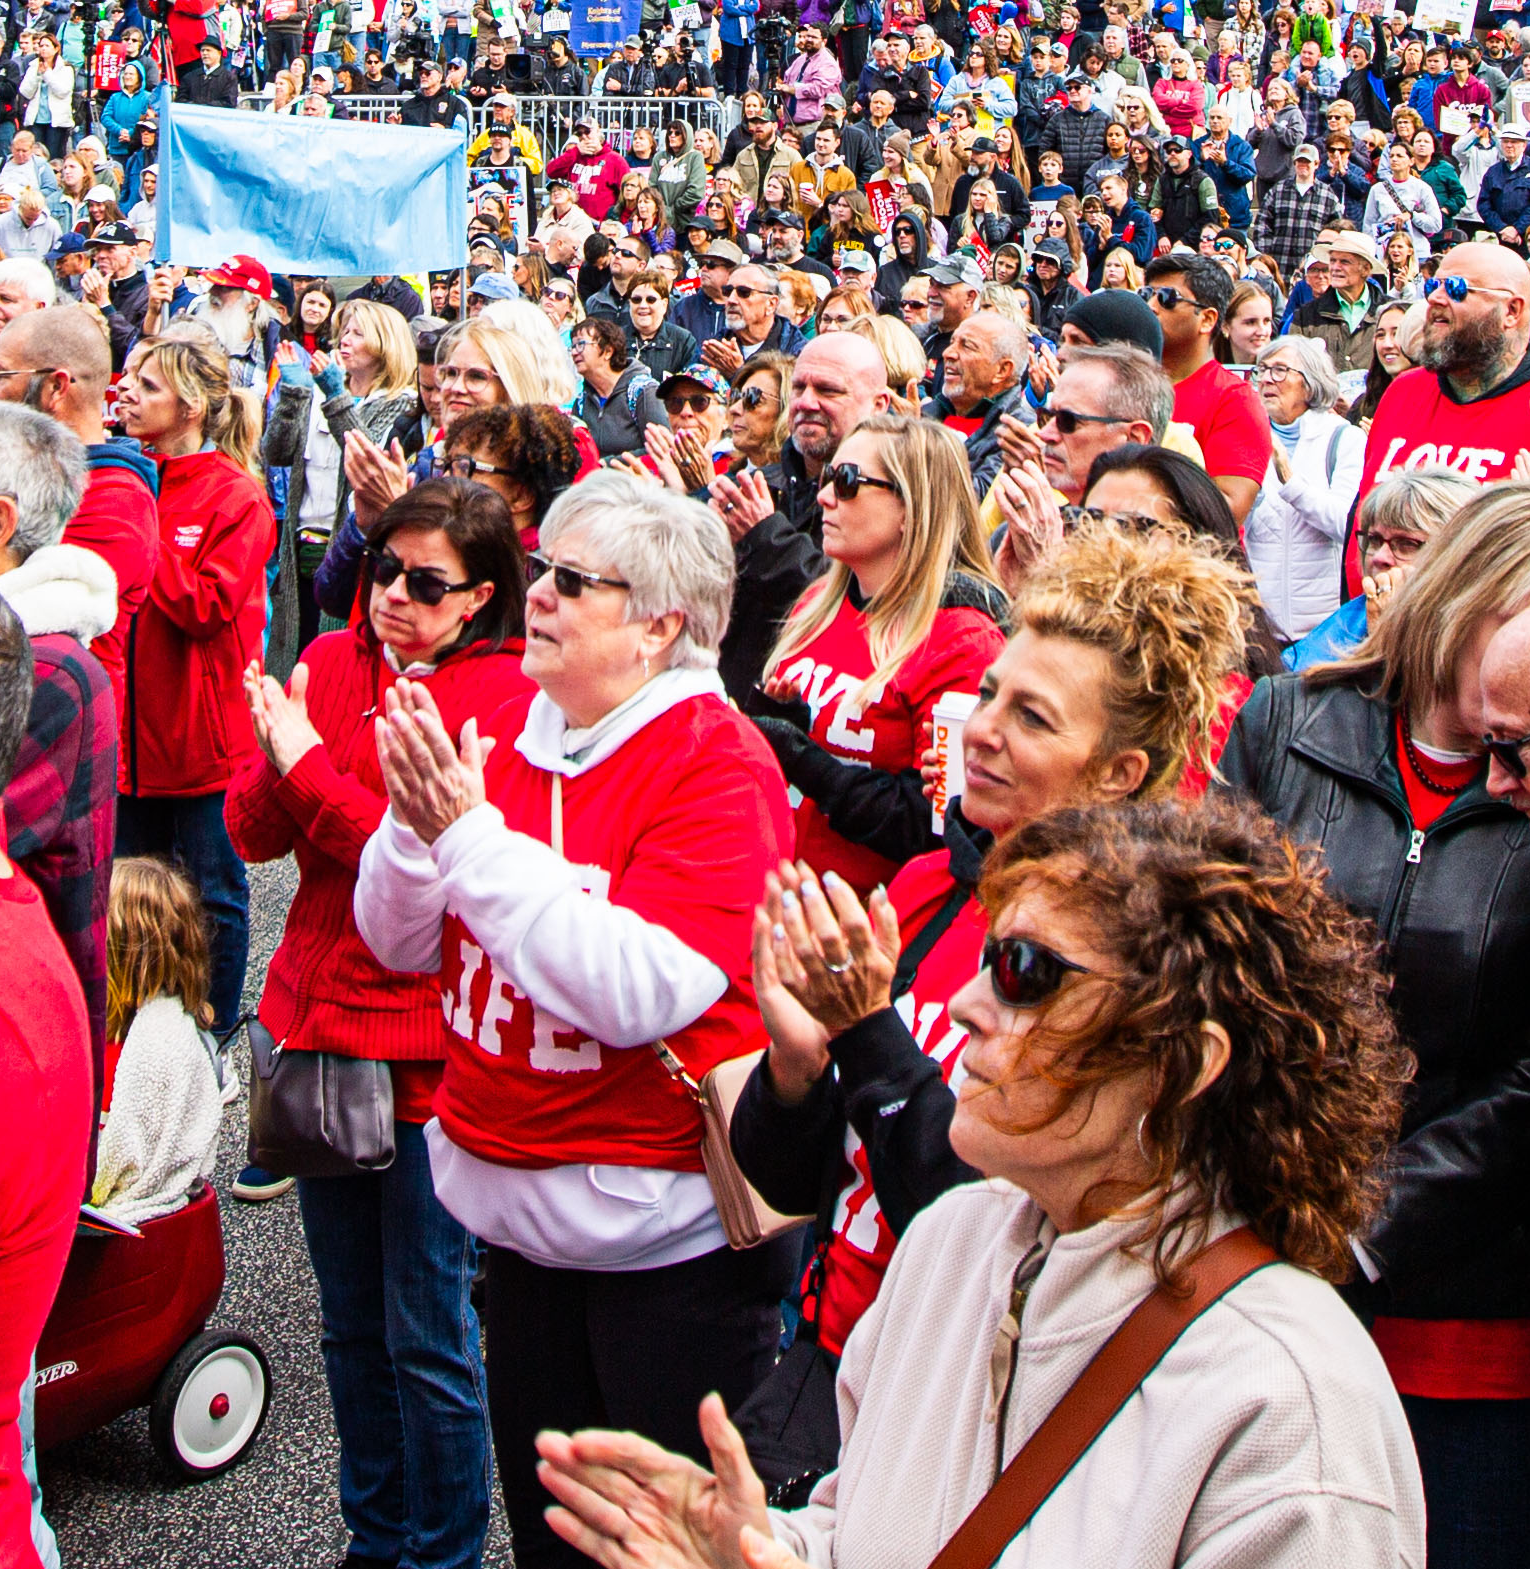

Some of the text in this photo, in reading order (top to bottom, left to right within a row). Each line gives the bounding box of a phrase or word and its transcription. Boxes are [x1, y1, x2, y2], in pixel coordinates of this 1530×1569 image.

[873, 188, 887, 231] CHOOSE
[1374, 437, 1506, 487] LOVE
[781, 657, 885, 752] OVE
[34, 1361, 78, 1388] LYER
